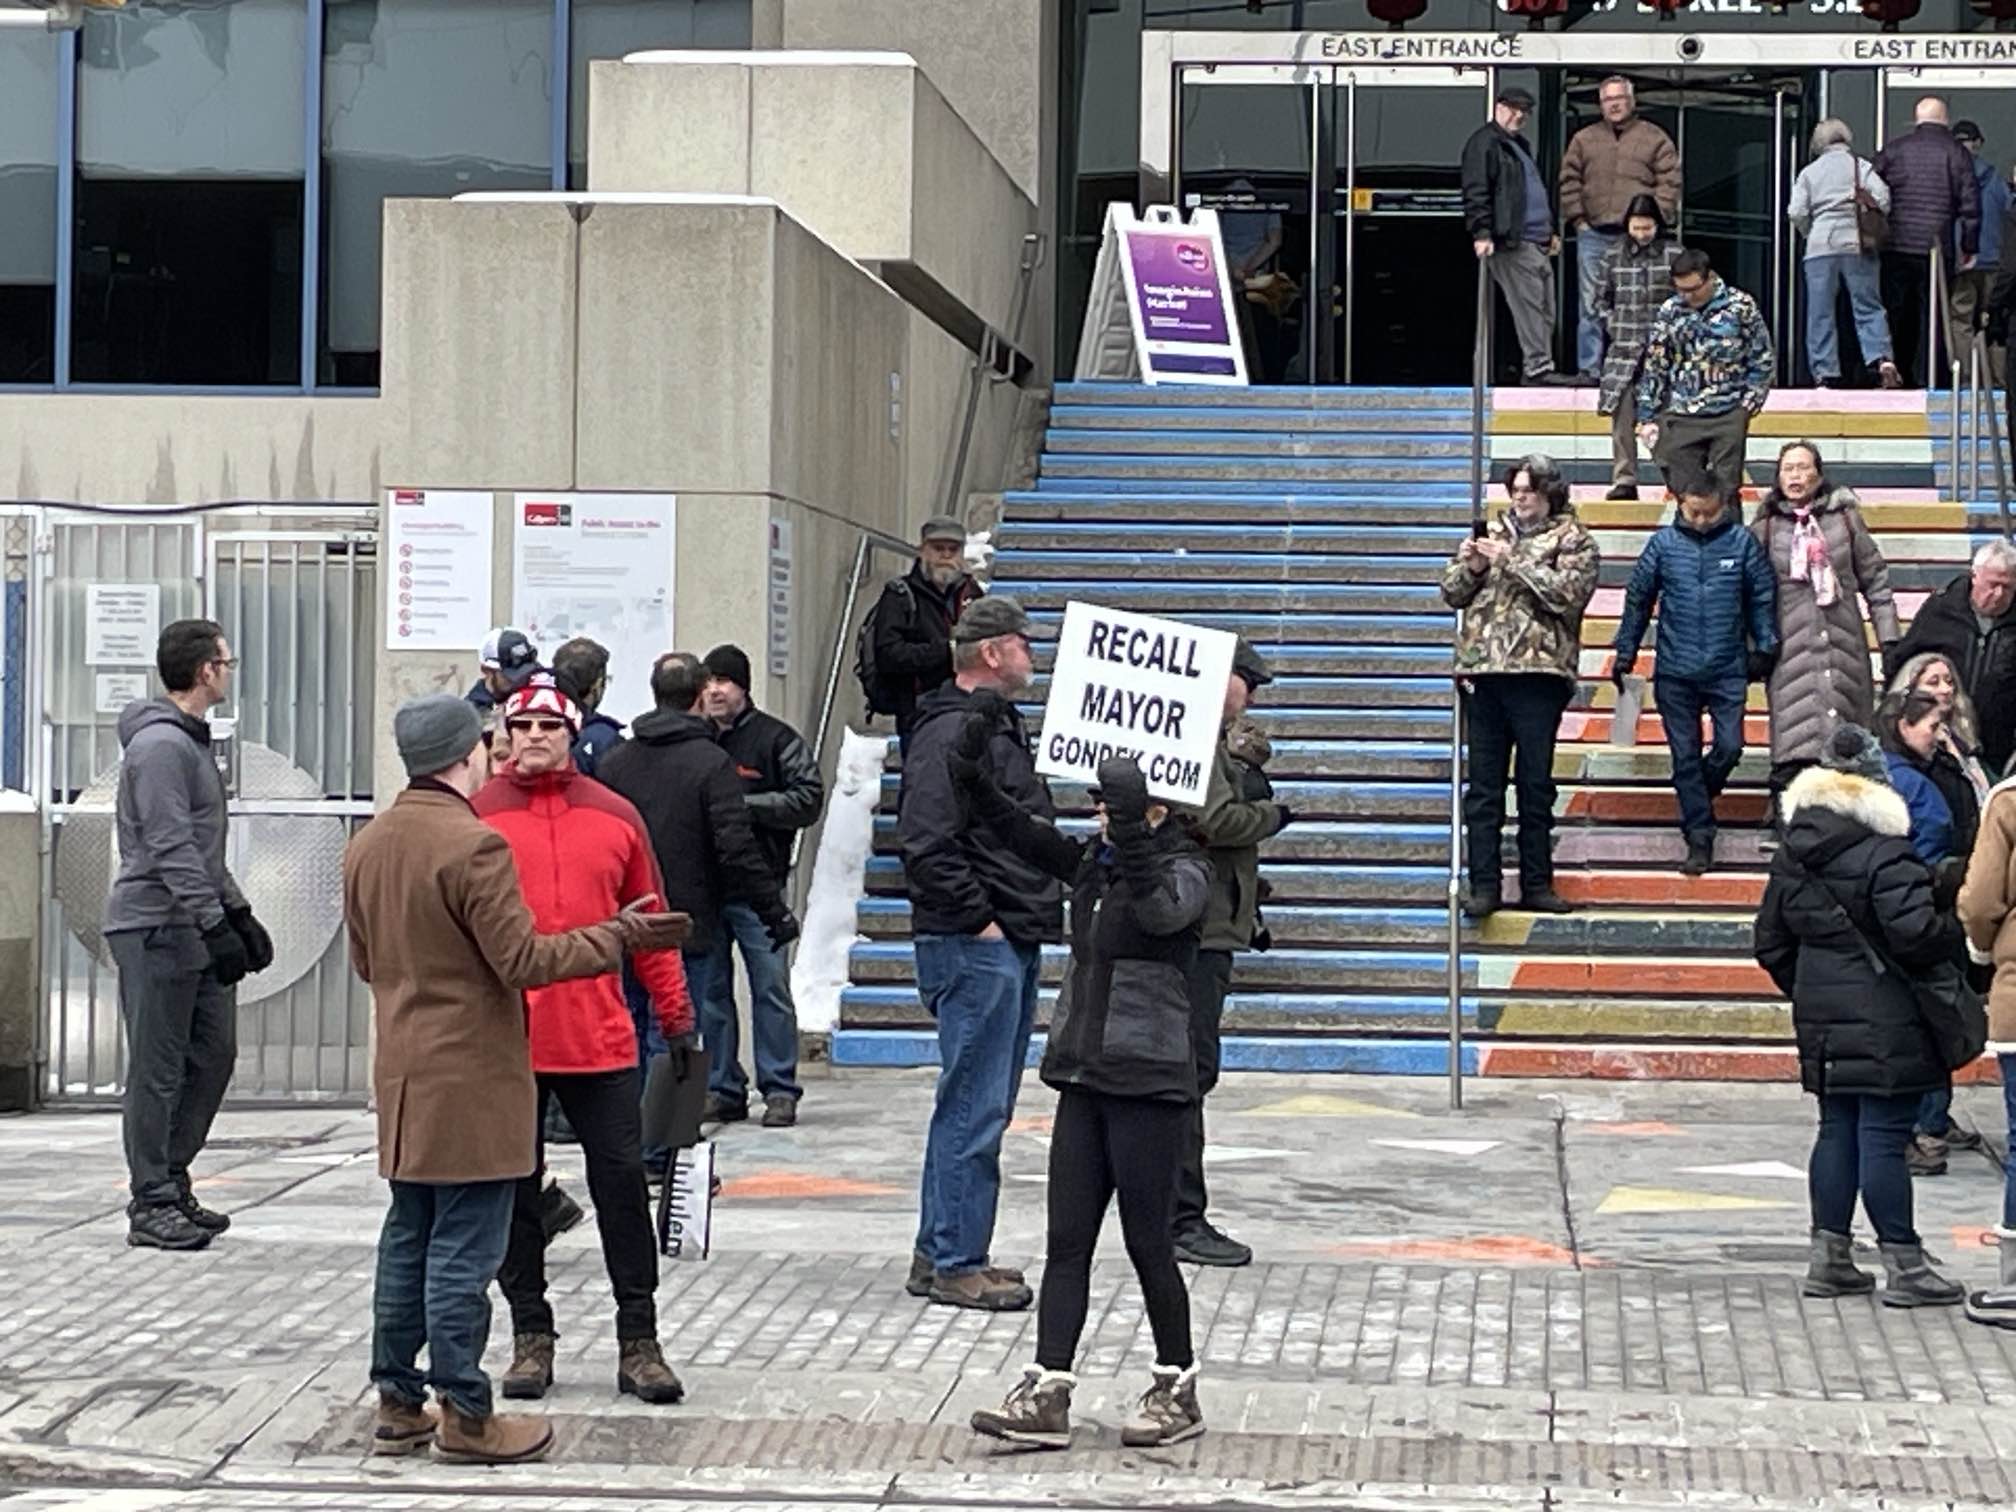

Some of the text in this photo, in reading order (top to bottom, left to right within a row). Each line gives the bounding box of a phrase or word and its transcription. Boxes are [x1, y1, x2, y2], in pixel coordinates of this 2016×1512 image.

[1321, 37, 1522, 57] EAST ENTRANCE
[1854, 39, 1916, 59] EAST
[1087, 620, 1201, 678] RECALL
[1080, 683, 1186, 739] MAYOR
